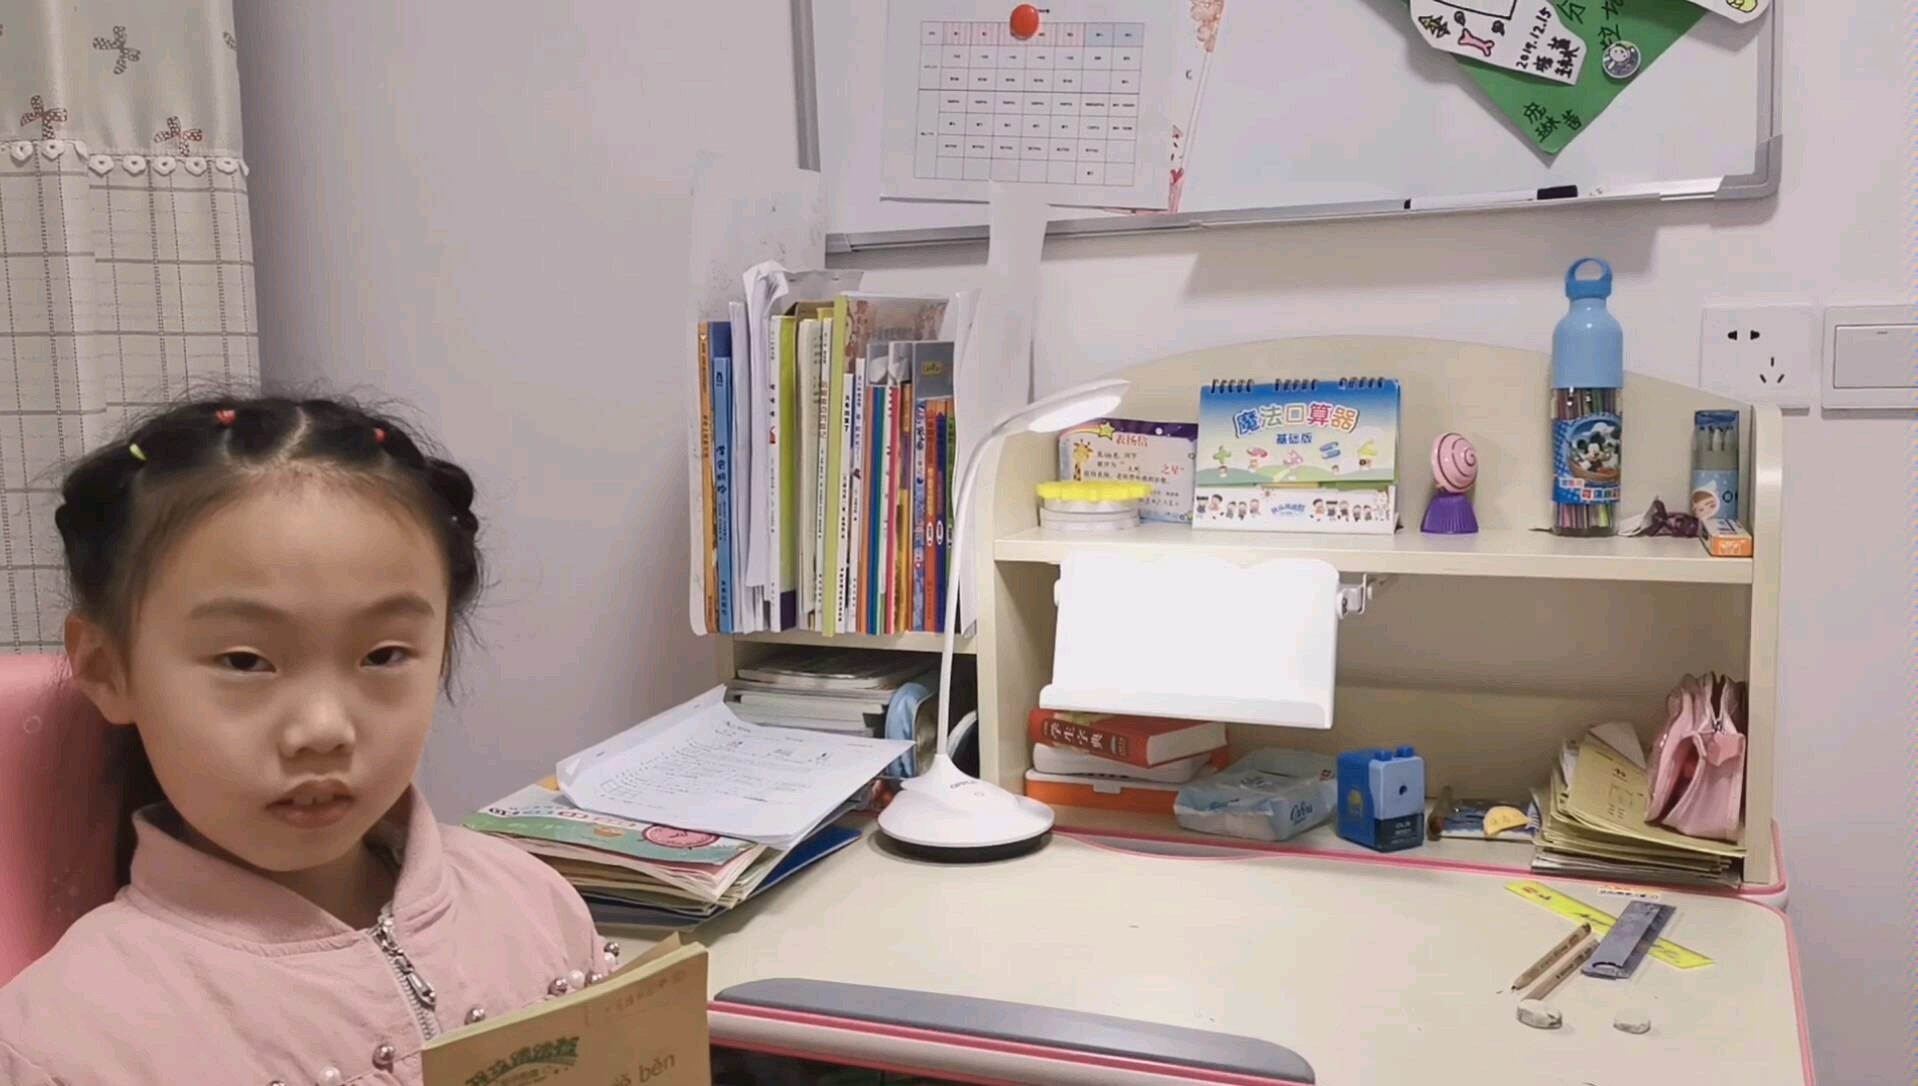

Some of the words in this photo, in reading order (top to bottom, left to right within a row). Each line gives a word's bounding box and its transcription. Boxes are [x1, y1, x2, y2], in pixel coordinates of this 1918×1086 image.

[1516, 7, 1552, 69] 2019.12.15
[1236, 403, 1357, 435] 魔法口算器
[1276, 432, 1313, 444] 基础版
[1050, 722, 1104, 750] 学生字典
